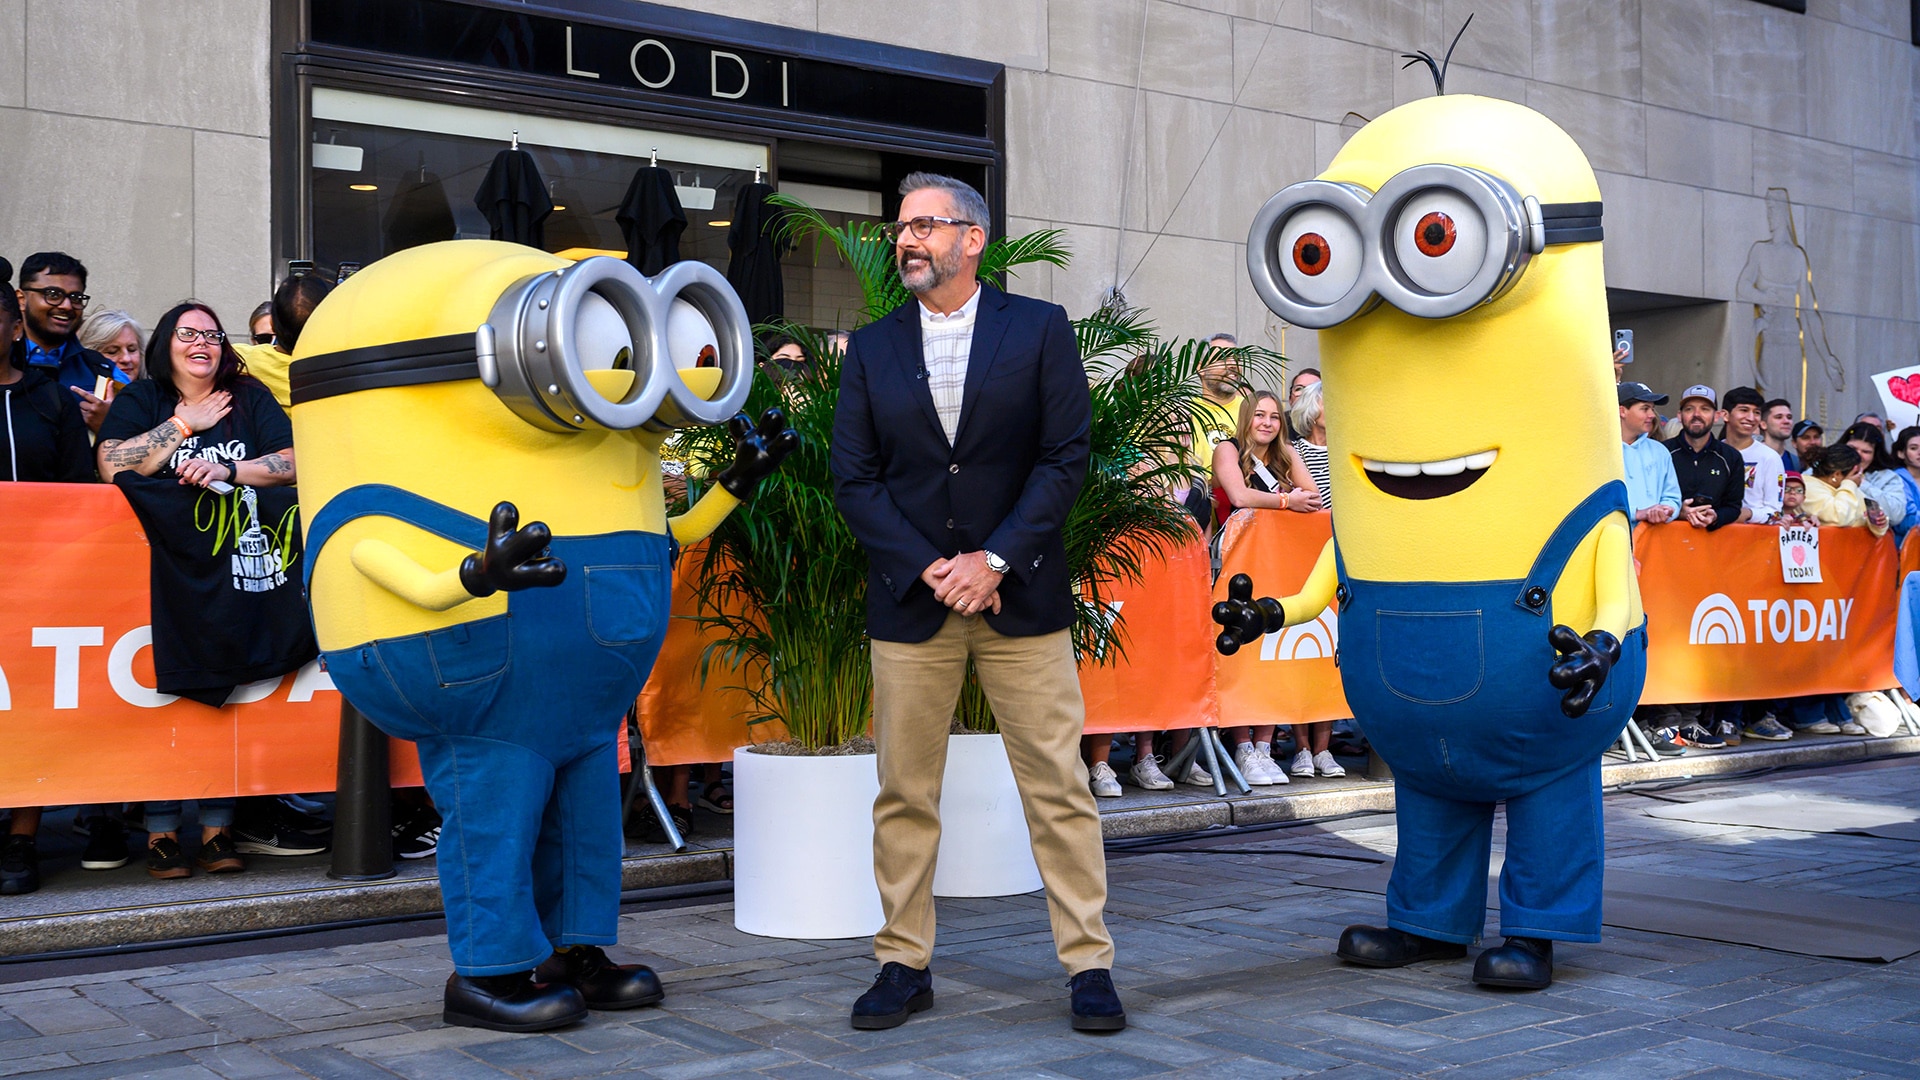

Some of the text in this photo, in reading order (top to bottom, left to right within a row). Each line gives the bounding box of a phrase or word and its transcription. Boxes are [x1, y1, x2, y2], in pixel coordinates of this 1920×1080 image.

[566, 26, 788, 107] LODI
[1781, 530, 1813, 546] PARKER
[1788, 567, 1814, 578] TODAY
[1748, 598, 1854, 643] TODAY
